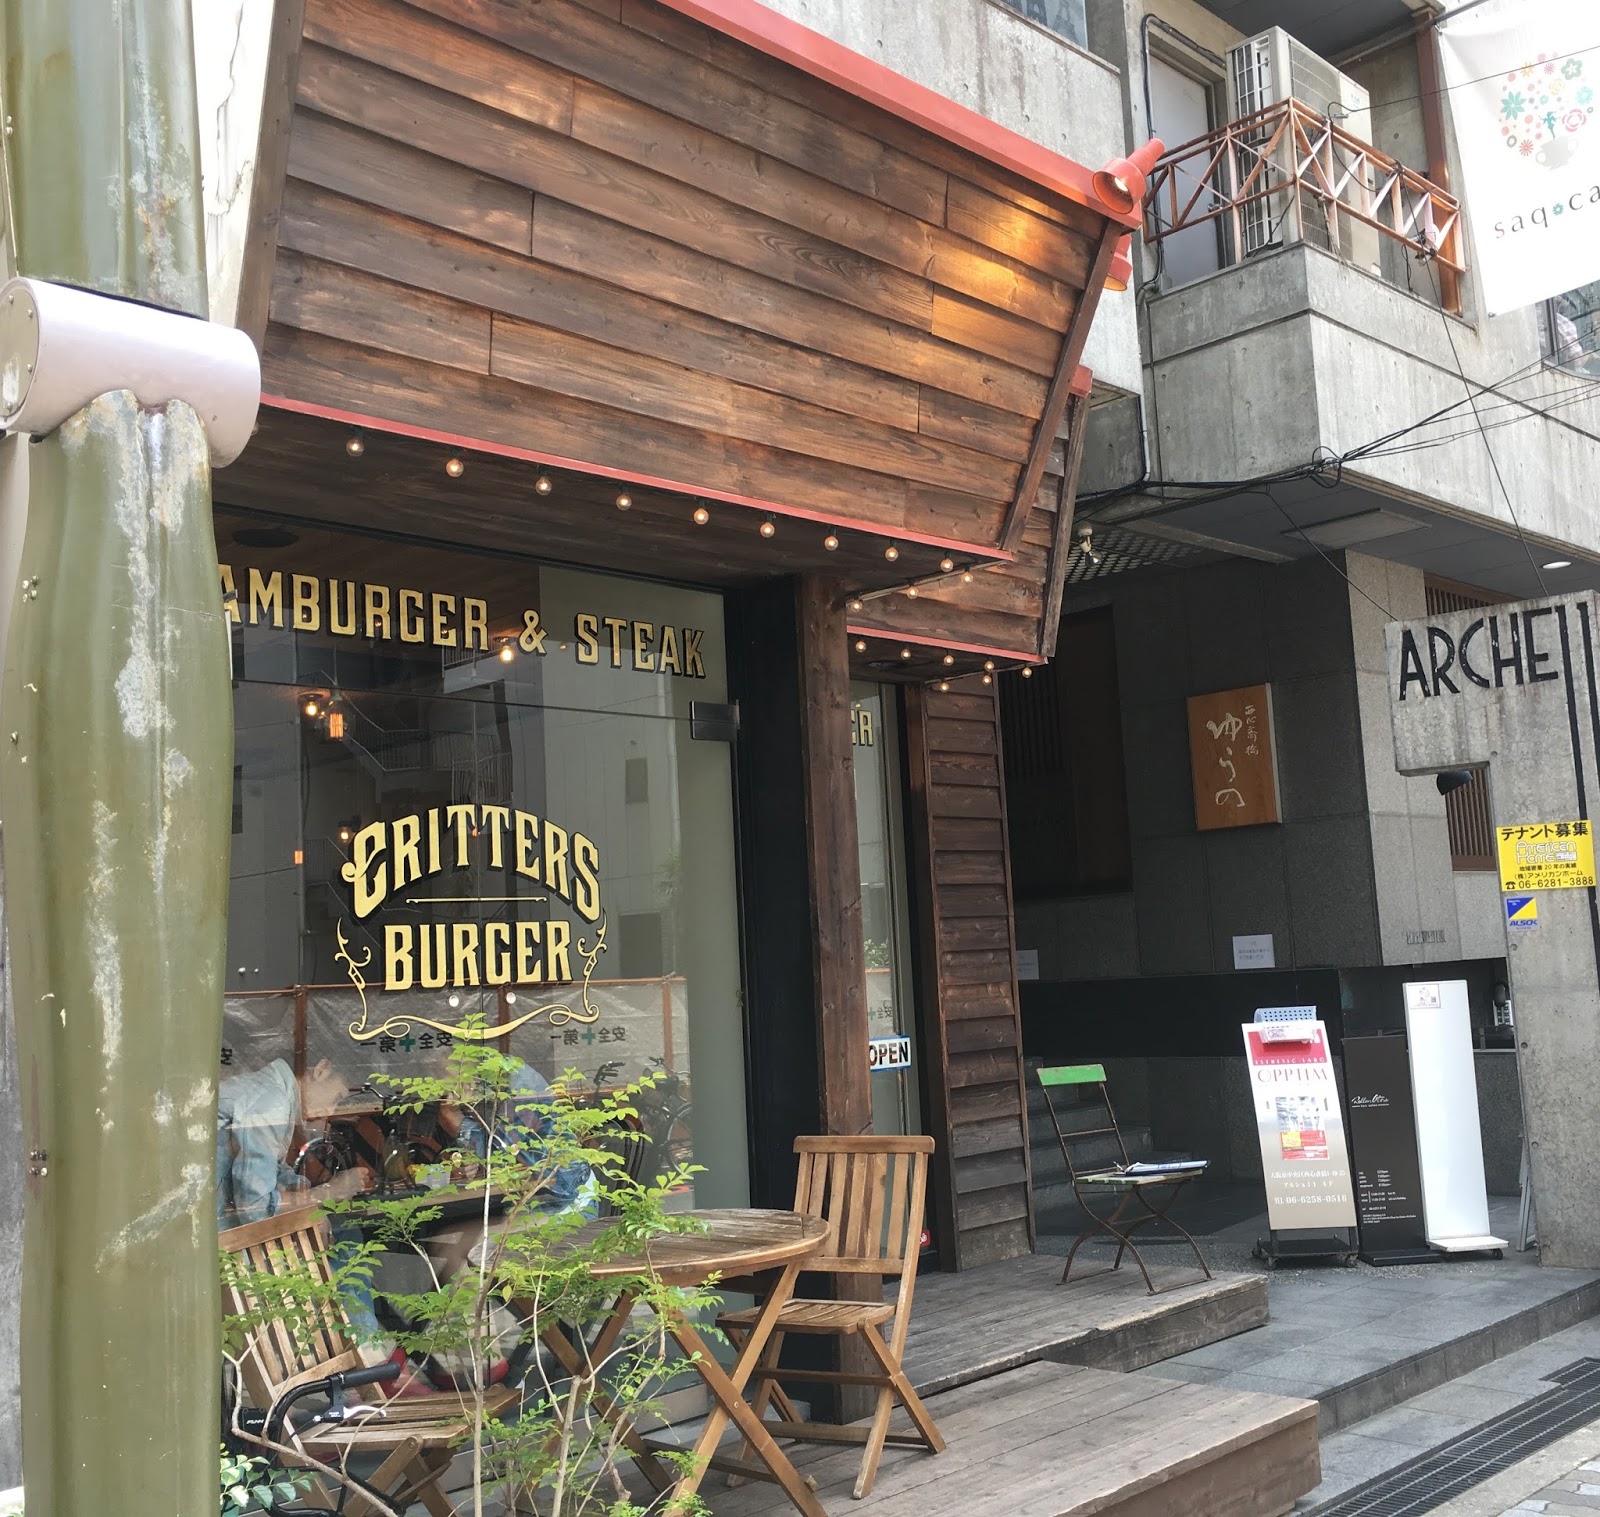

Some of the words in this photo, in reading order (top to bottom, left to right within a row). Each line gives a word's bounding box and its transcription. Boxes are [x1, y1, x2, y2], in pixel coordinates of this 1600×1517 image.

[1494, 206, 1548, 239] saq
[518, 608, 547, 655] &
[574, 613, 706, 679] STEAK
[1501, 822, 1588, 841] テナント募集
[1516, 840, 1577, 854] American
[1516, 852, 1556, 864] Home
[340, 803, 600, 922] CRITTERS
[1518, 876, 1594, 889] 06-6281-3888
[383, 920, 573, 991] BURGER
[869, 1041, 909, 1067] OPEN
[1286, 1194, 1348, 1204] 06-6258-0516
